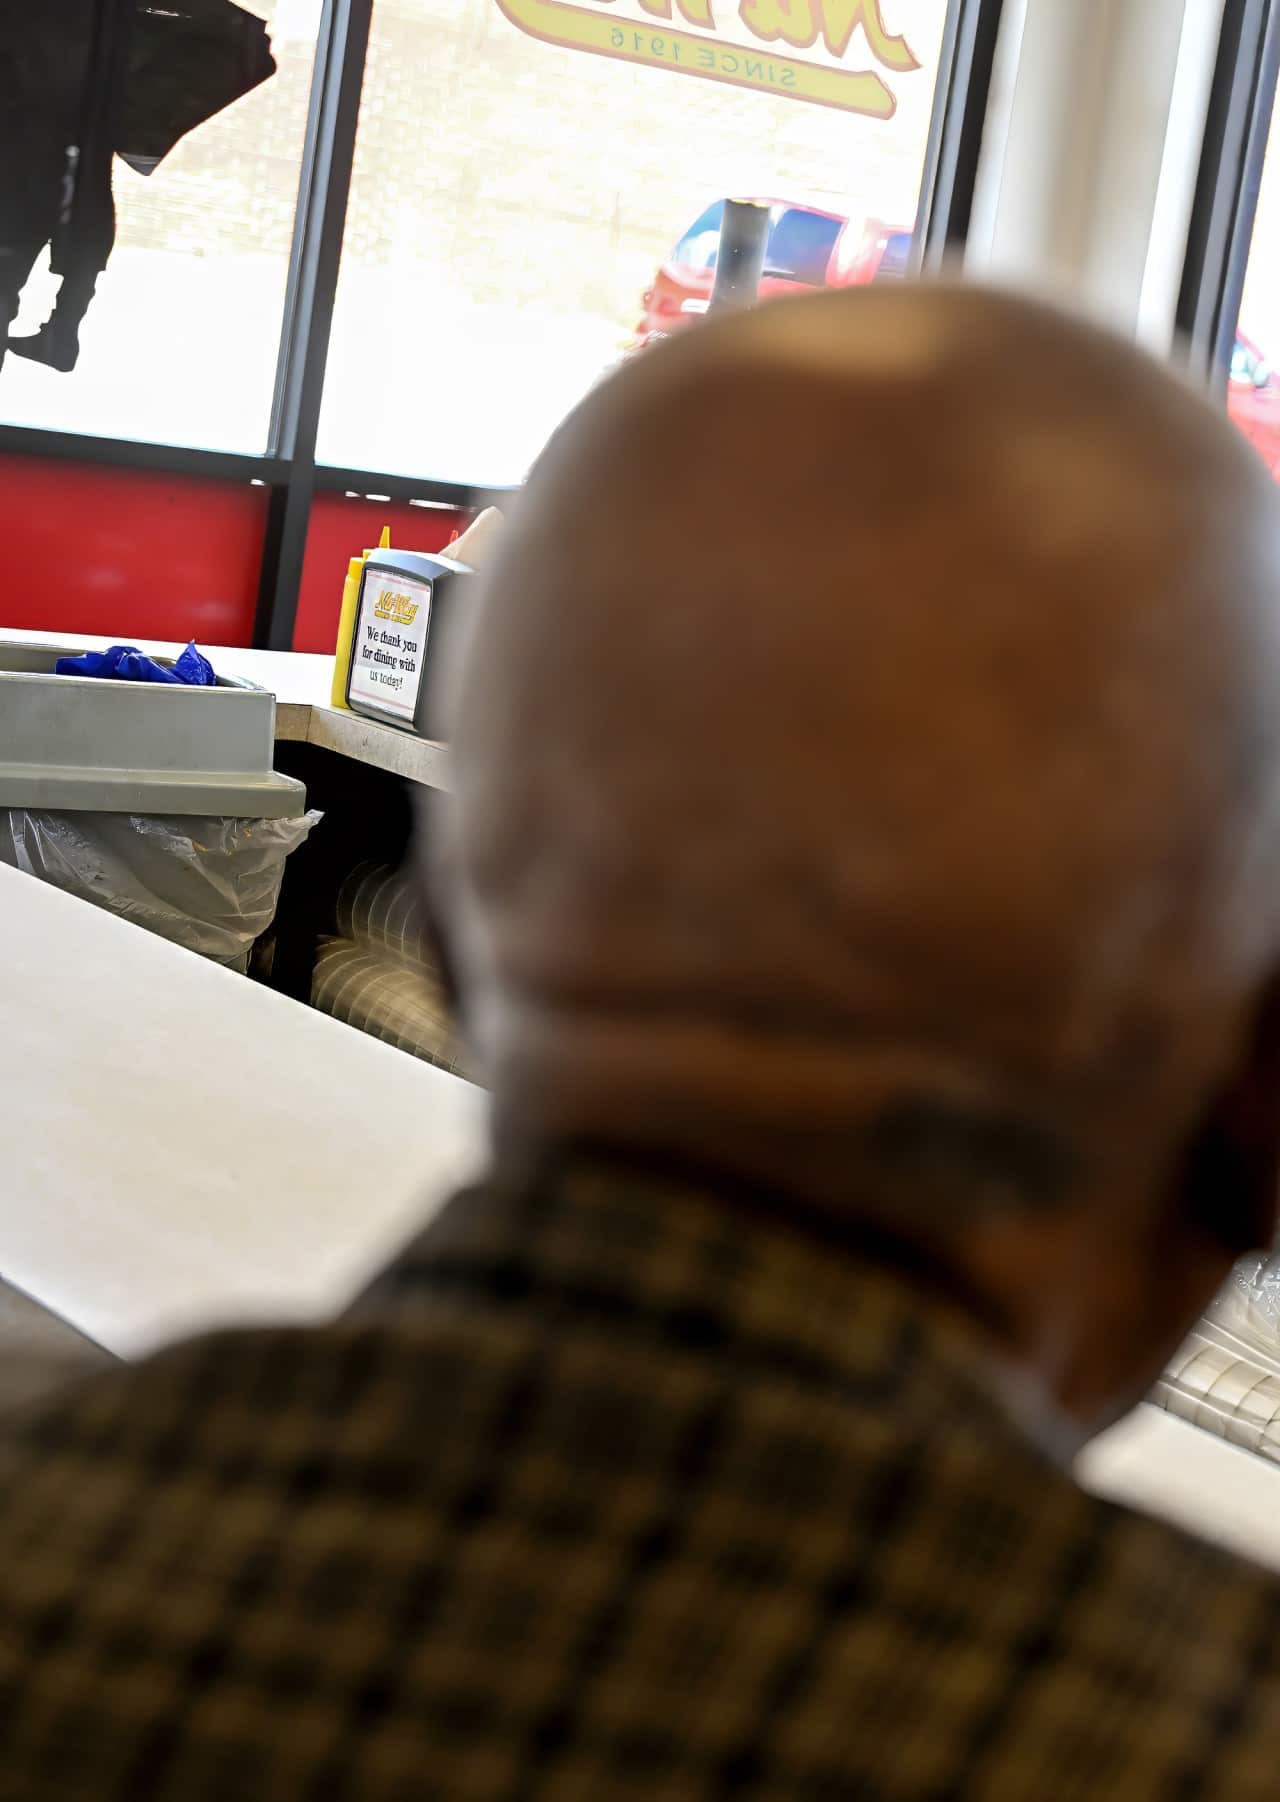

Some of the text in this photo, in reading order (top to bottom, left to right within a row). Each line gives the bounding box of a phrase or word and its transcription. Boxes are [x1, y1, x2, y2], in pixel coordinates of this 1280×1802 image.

[367, 626, 417, 653] We thank you
[362, 645, 416, 672] for dining with
[370, 670, 378, 681] us
